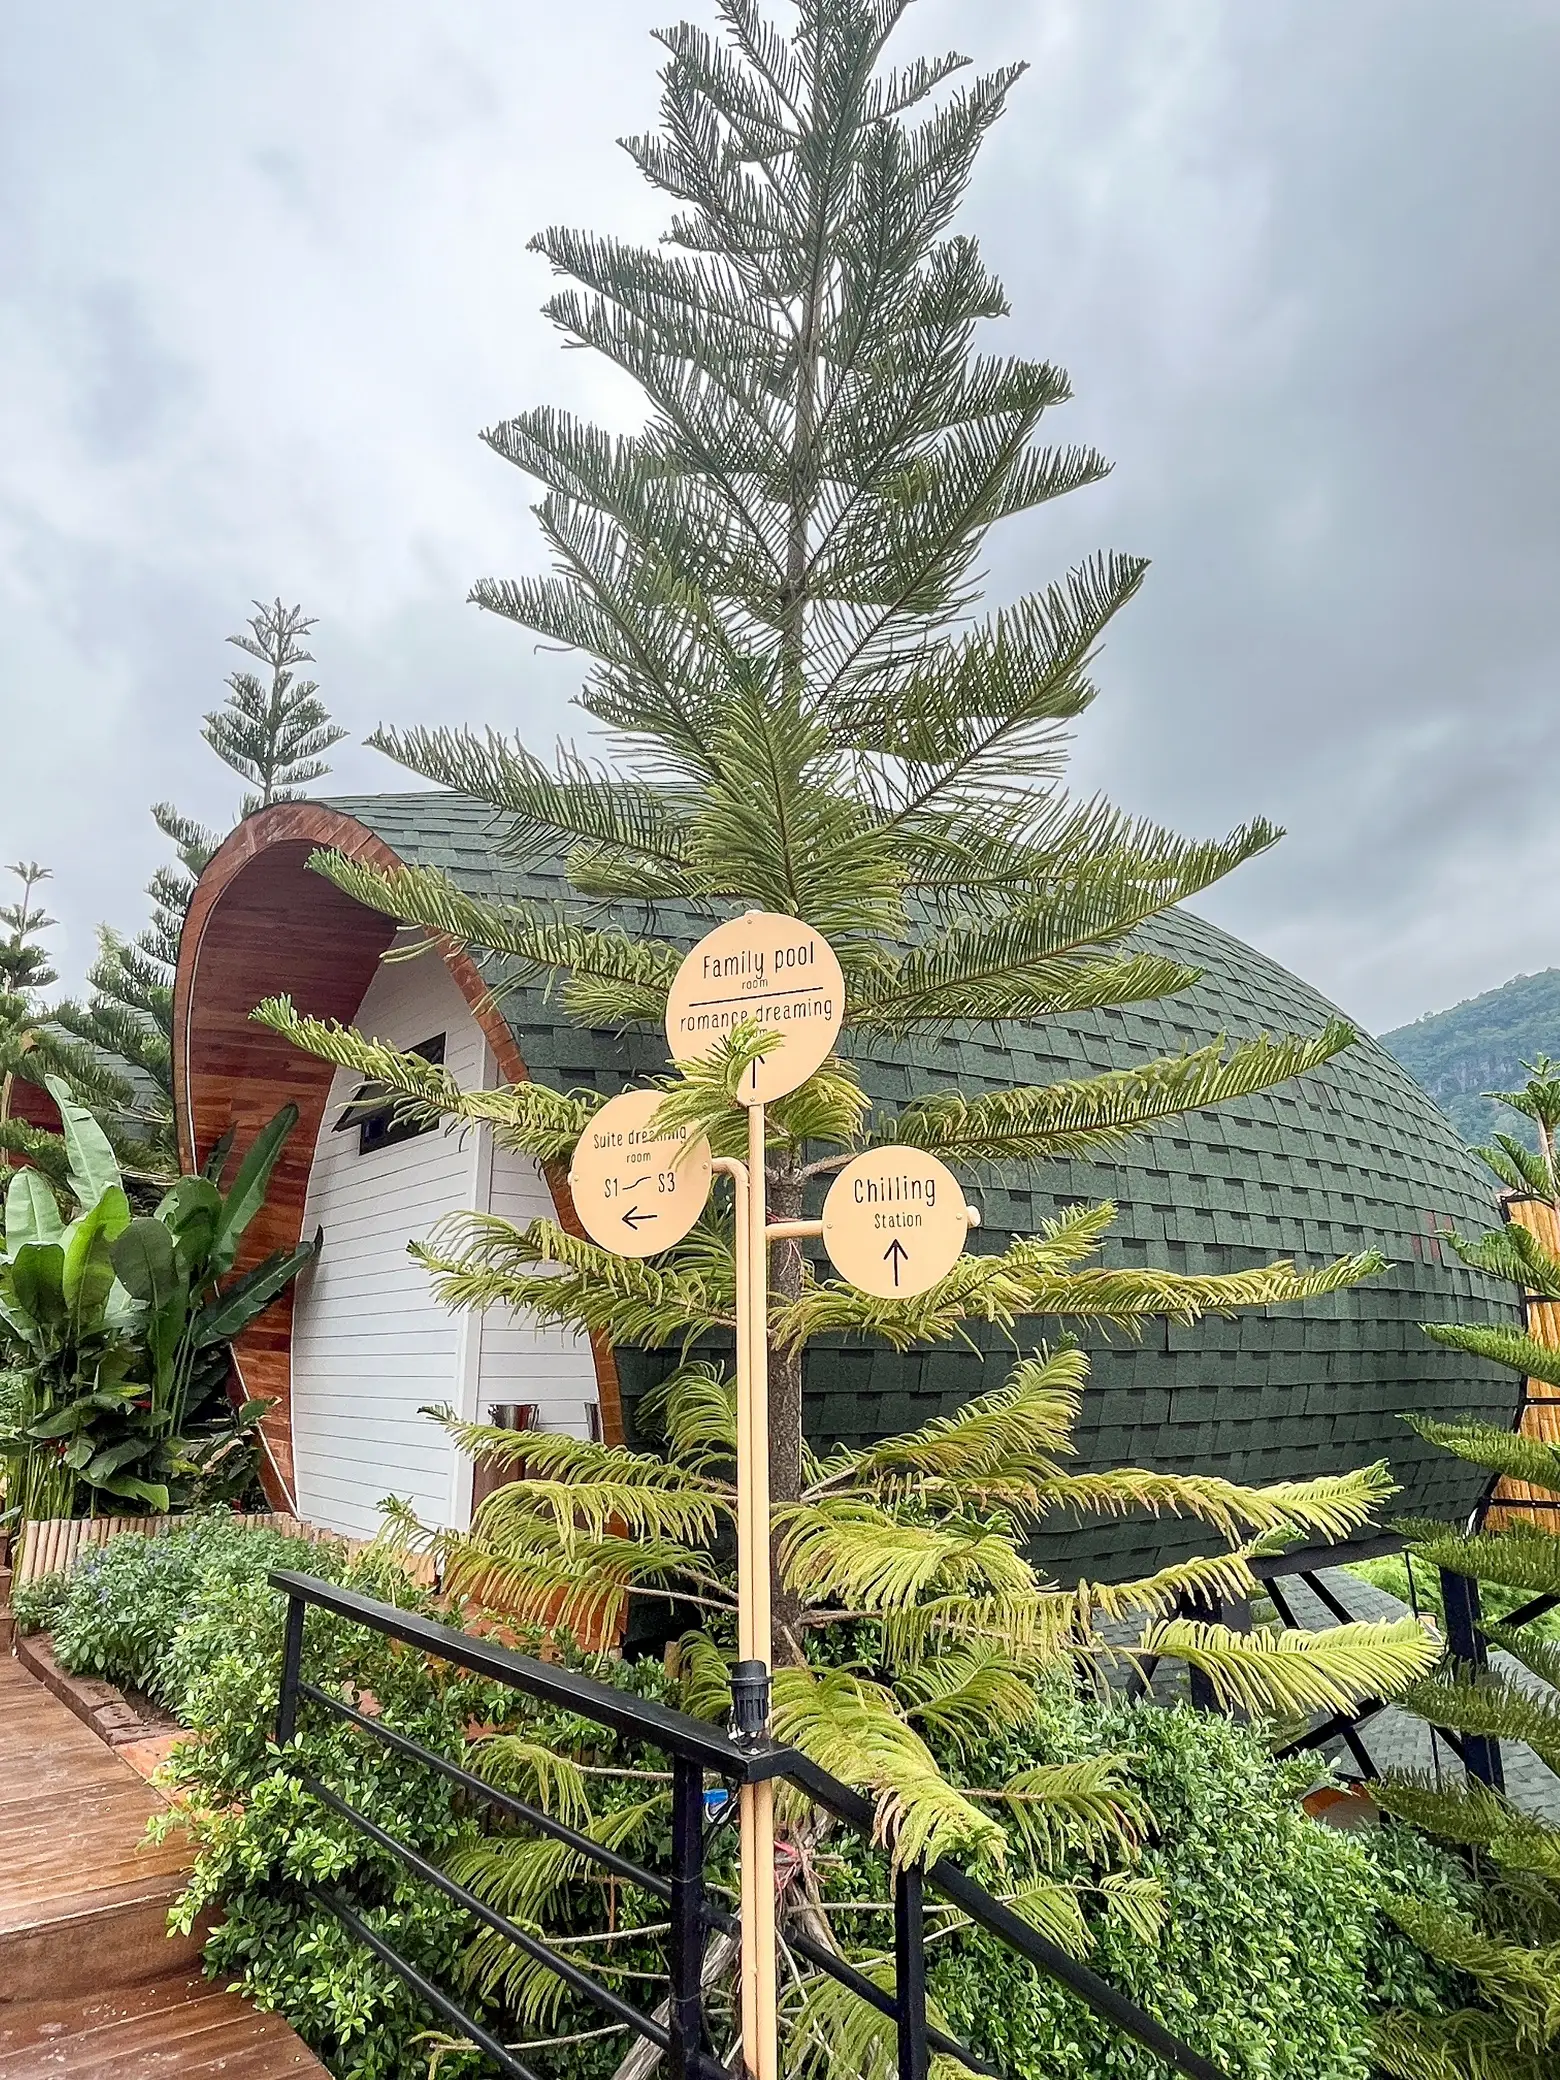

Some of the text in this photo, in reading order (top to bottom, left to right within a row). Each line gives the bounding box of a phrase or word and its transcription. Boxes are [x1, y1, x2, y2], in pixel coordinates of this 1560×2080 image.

[703, 941, 814, 980] Family pool
[741, 978, 768, 990] room
[680, 998, 832, 1032] romance dreaming
[593, 1132, 623, 1149] Suite
[626, 1152, 652, 1164] room
[604, 1172, 675, 1198] S1 S3
[854, 1175, 935, 1207] Chilling
[874, 1211, 922, 1230] Station
